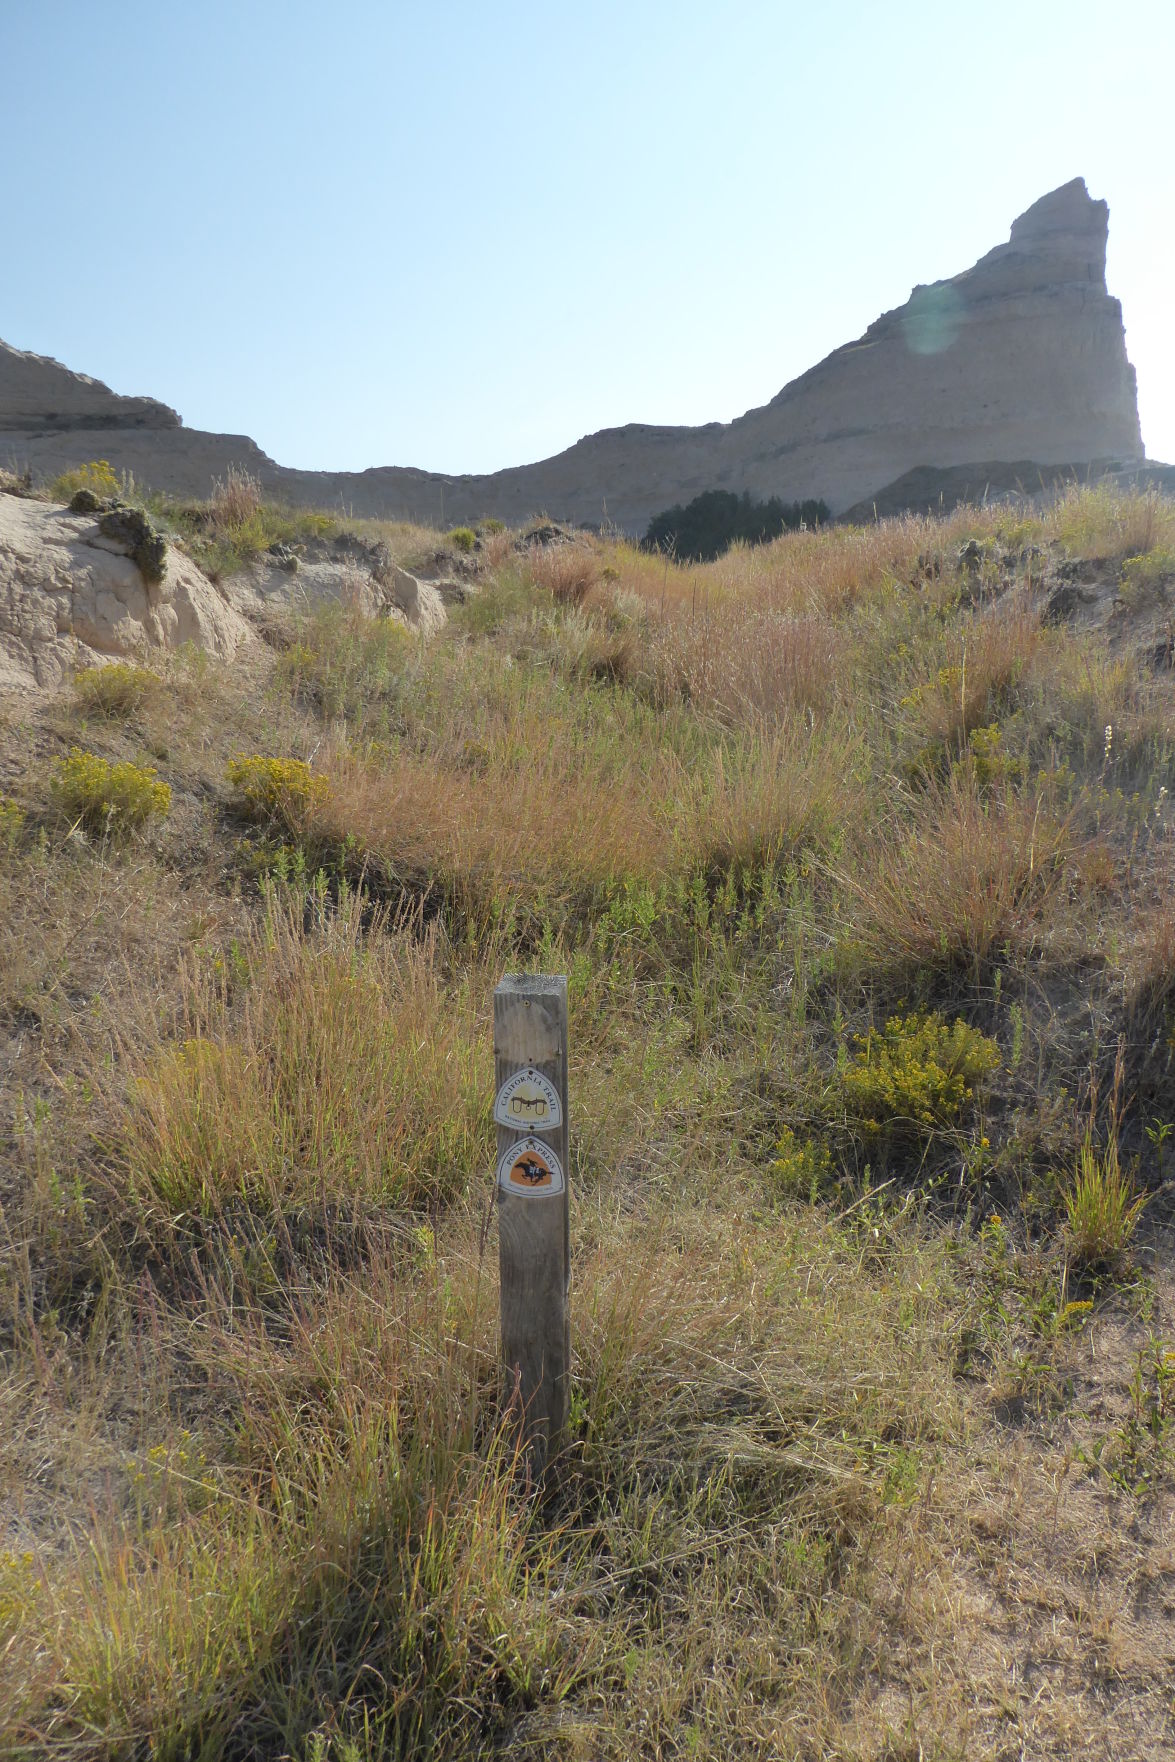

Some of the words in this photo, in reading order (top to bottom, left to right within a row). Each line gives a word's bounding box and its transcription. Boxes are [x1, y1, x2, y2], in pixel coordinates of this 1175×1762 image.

[502, 1075, 542, 1106] CALIFORNIA
[543, 1086, 557, 1112] TRAIL
[507, 1147, 523, 1166] PONY
[525, 1144, 556, 1169] EXPRESS
